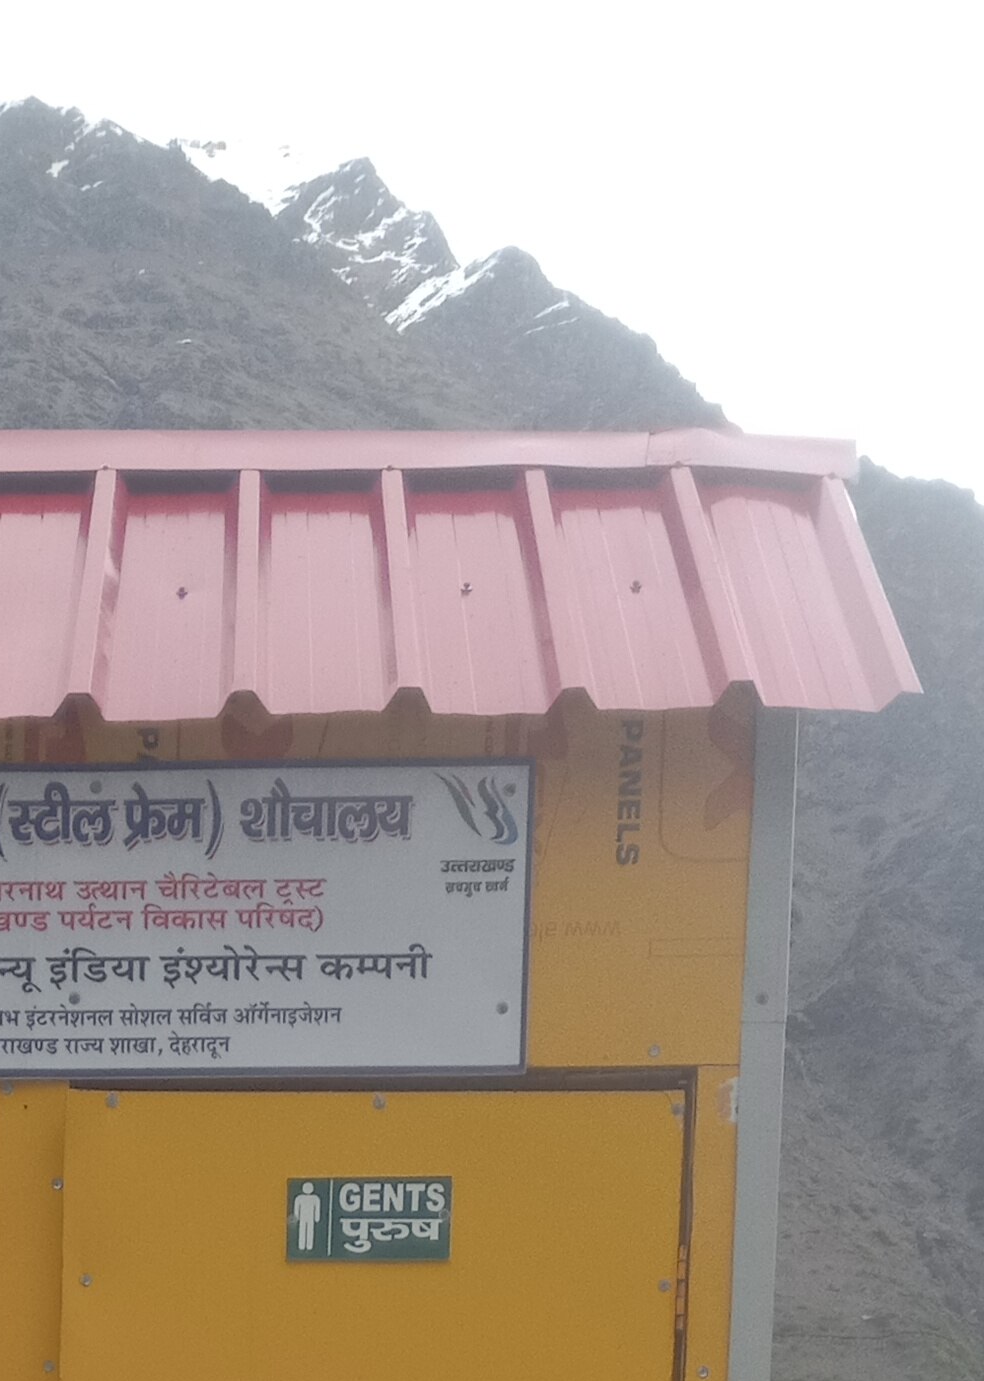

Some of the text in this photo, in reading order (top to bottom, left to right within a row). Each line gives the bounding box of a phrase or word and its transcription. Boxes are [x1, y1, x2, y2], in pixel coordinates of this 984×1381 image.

[616, 719, 643, 866] PANELS
[122, 779, 224, 859] फ्रेम)
[240, 777, 415, 843] शौचालय
[440, 859, 516, 873] उत्तराखण्ड
[73, 880, 147, 901] उत्थान
[155, 871, 266, 901] चैरिटेबल
[274, 878, 327, 905] ट्रस्ट
[57, 903, 133, 931] पर्यटन
[141, 903, 228, 930] विकास
[235, 902, 323, 932] परिषद)
[46, 947, 150, 990] इंडिया
[159, 945, 307, 989] इंश्योरेन्स
[316, 944, 433, 980] कम्पनी
[25, 1004, 113, 1030] इंटरनेशनल
[119, 1003, 172, 1026] सोशल
[64, 1037, 104, 1054] राज्य
[109, 1037, 163, 1056] शाखा,
[168, 1031, 230, 1059] देहरादून
[339, 1182, 446, 1212] GENTS
[339, 1218, 444, 1254] पुरुष
